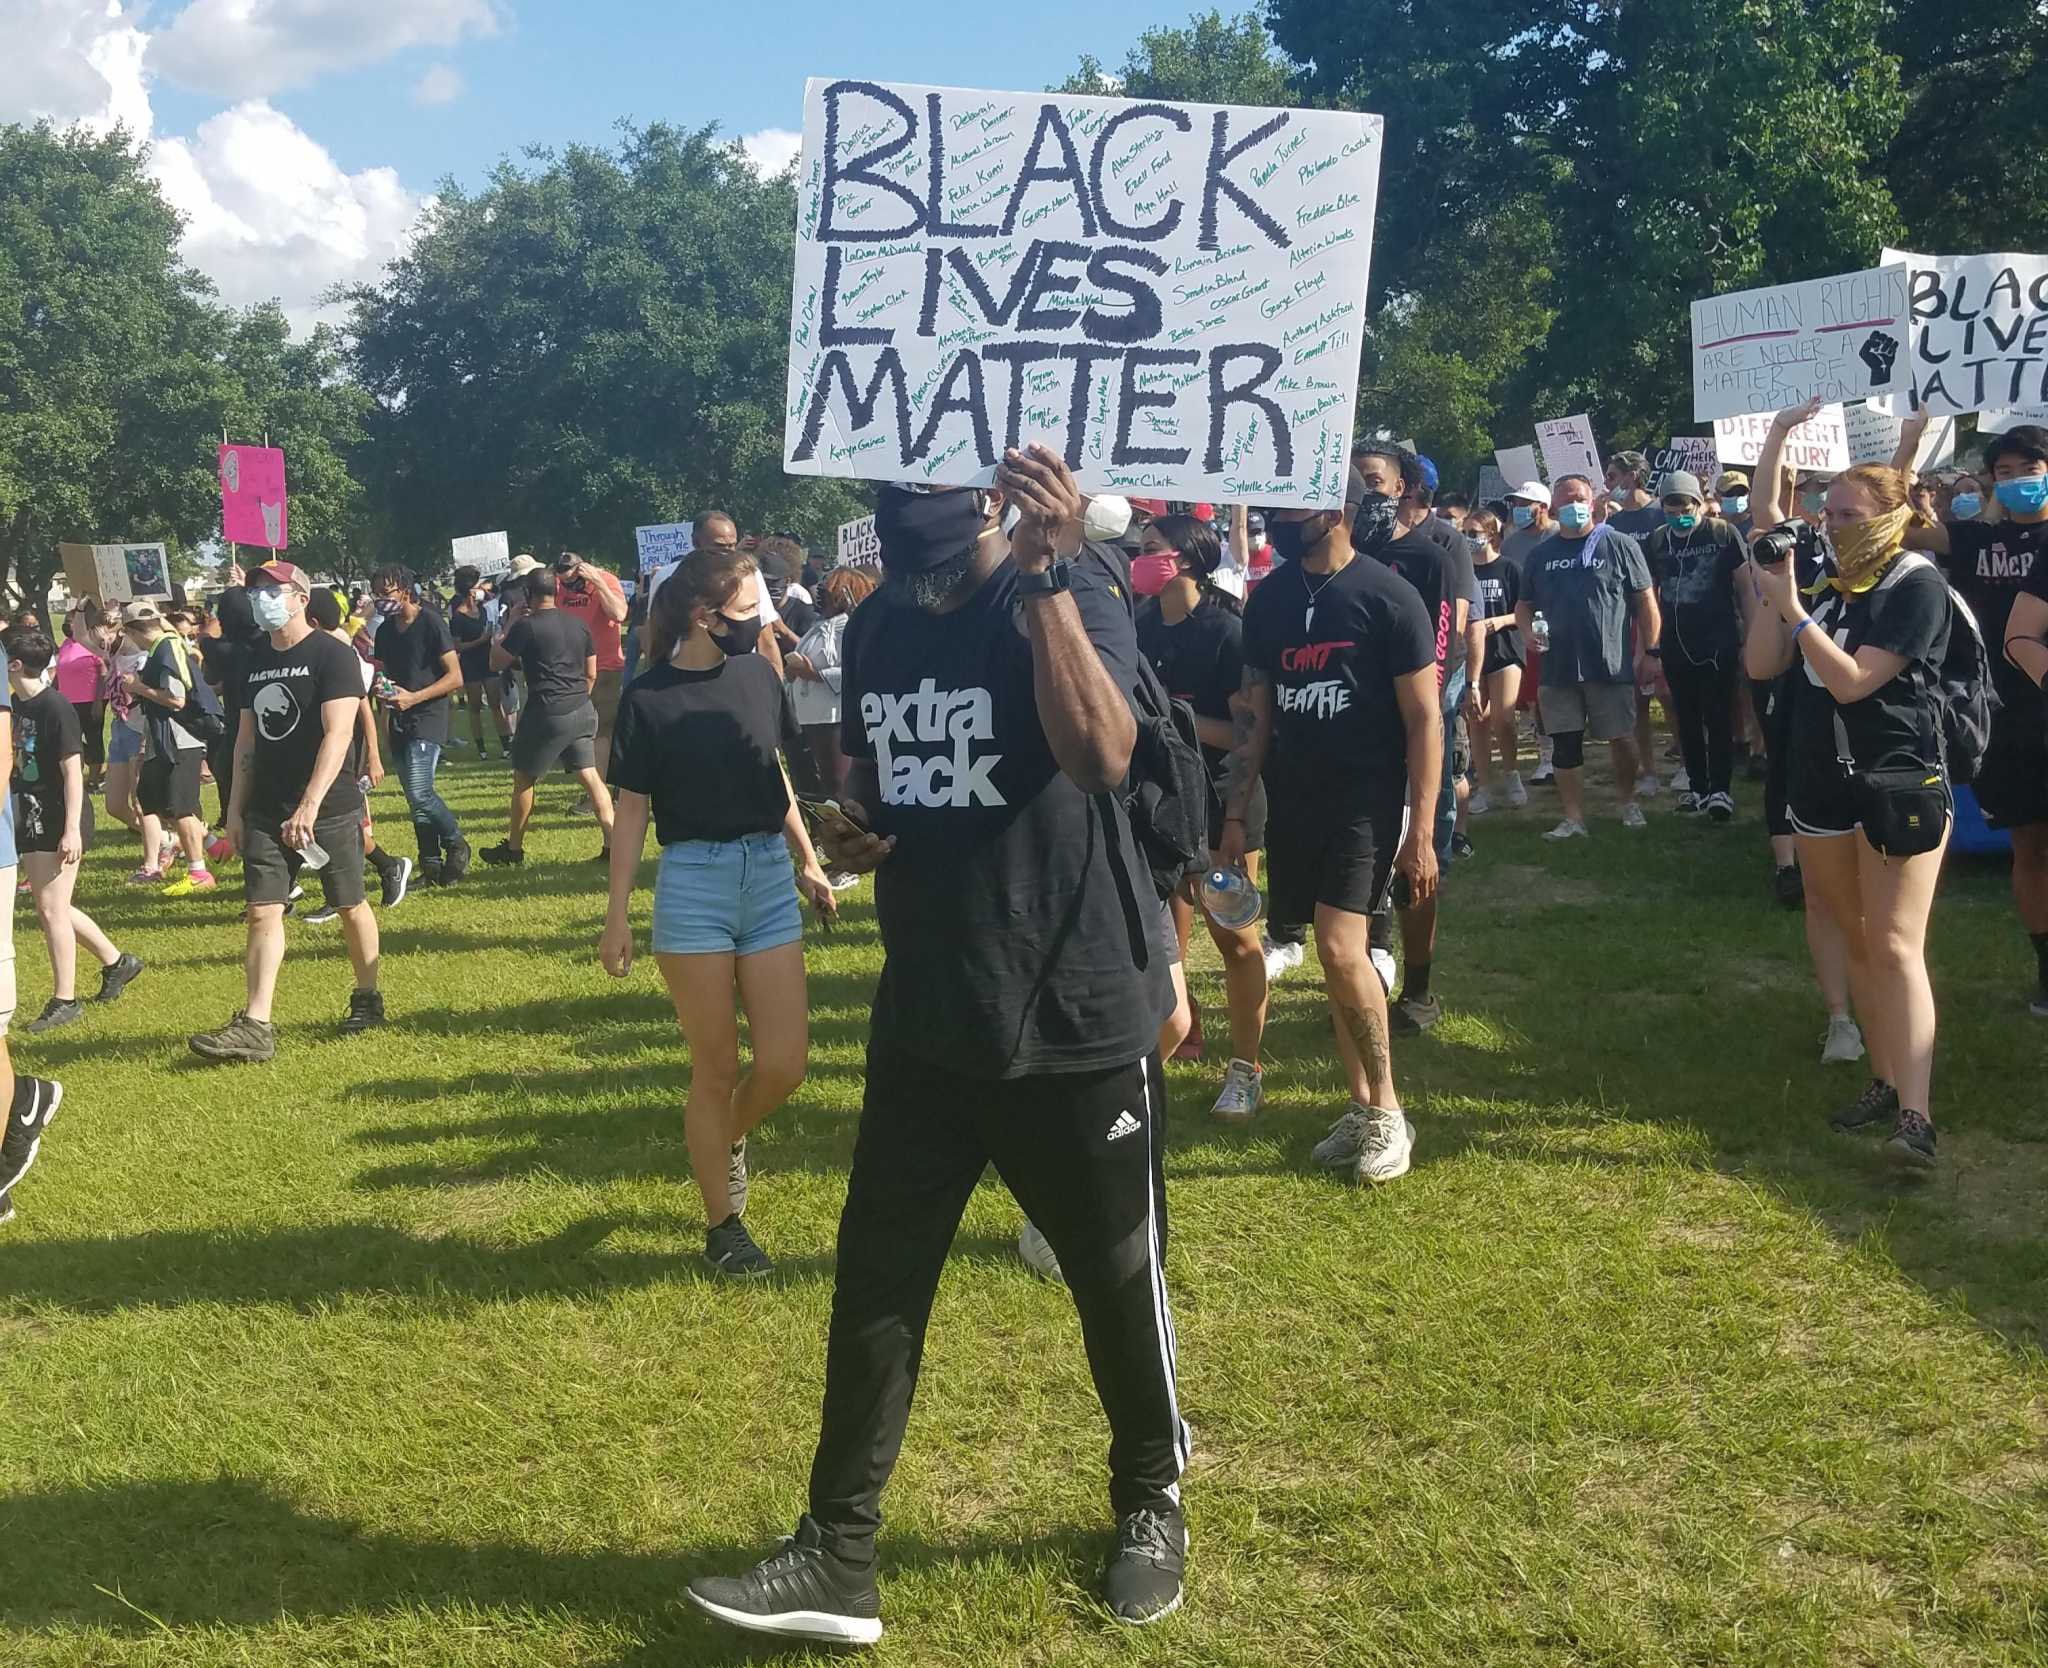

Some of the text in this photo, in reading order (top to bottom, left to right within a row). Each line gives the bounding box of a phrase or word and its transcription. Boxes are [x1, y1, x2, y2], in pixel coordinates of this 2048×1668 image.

[1274, 128, 1307, 162] Turner
[816, 80, 1292, 251] BLACK
[1297, 203, 1334, 228] Freddie
[818, 238, 1171, 350] LIVES
[1294, 272, 1326, 297] Floyd
[1701, 270, 1906, 344] HUMAN RIGHTS
[1328, 329, 1350, 349] Till
[1703, 333, 1854, 370] ARE NEVER A
[1274, 375, 1338, 392] Mike Brown
[1703, 359, 1848, 392] MATTER OF
[790, 340, 1294, 477] MATTER
[1721, 417, 1841, 444] DIFFRENT
[1681, 439, 1710, 452] SAY
[1742, 442, 1831, 467] CETURY
[1102, 469, 1179, 487] Jamar Clark
[843, 520, 873, 544] BLACK
[847, 536, 877, 557] LIVES
[1436, 600, 1451, 660] GOOD
[290, 664, 310, 677] MA
[861, 678, 995, 744] extra
[873, 738, 1008, 808] lack
[1107, 1120, 1142, 1141] adidas
